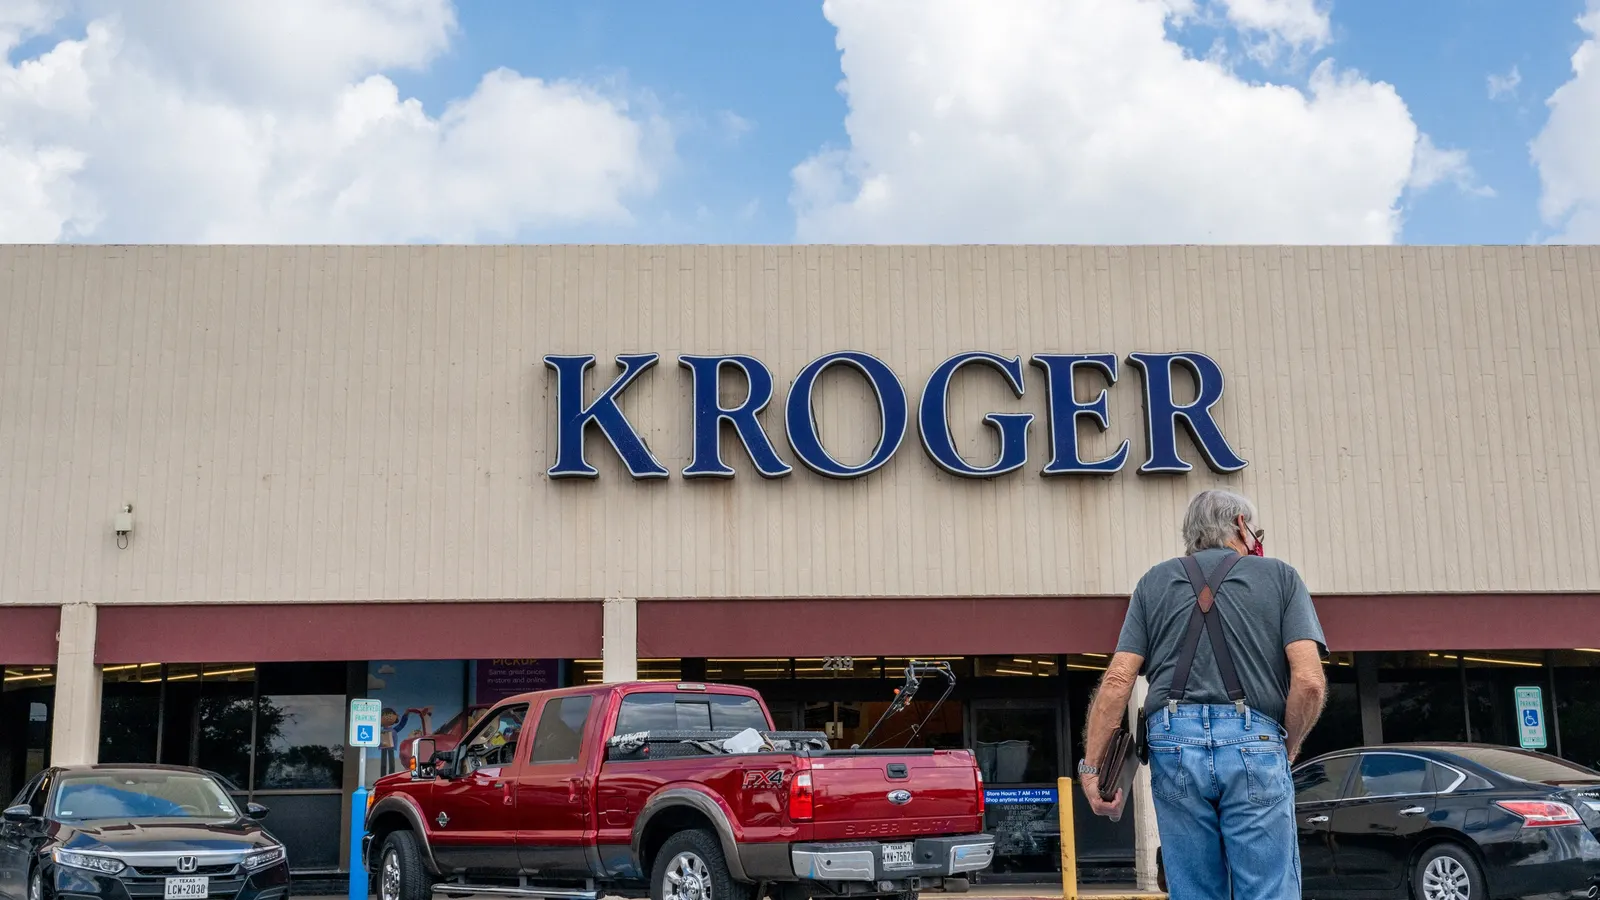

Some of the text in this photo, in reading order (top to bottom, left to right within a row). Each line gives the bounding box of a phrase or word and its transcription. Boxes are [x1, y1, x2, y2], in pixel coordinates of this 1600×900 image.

[542, 350, 1249, 480] KROGER
[822, 656, 854, 670] 239
[743, 770, 785, 786] FX4
[846, 820, 950, 835] SUPER DUTY
